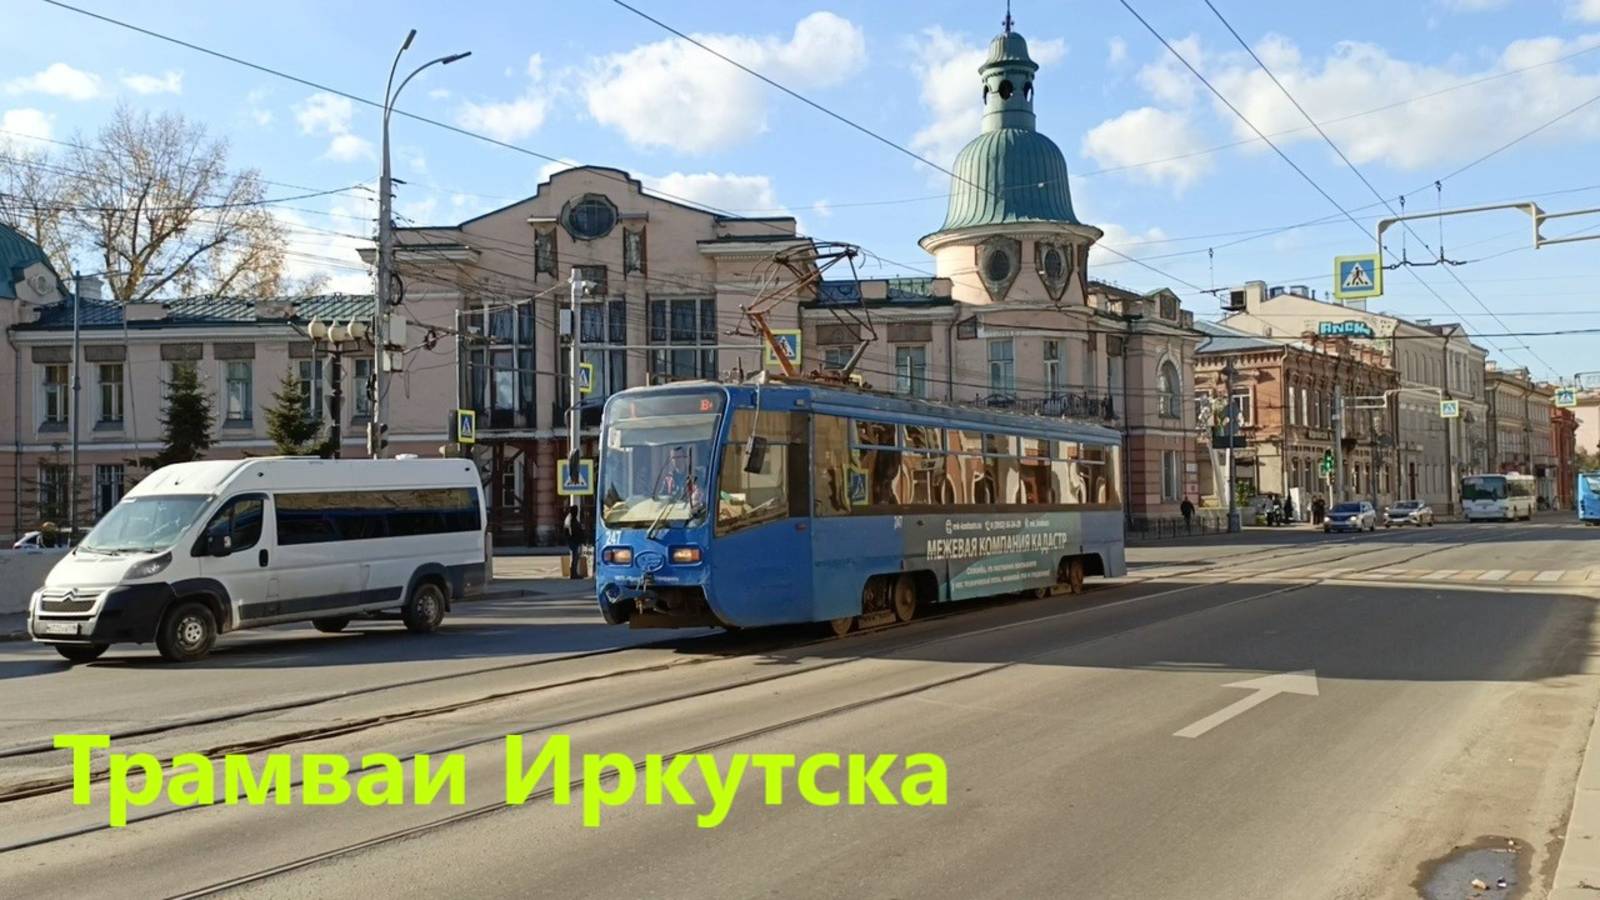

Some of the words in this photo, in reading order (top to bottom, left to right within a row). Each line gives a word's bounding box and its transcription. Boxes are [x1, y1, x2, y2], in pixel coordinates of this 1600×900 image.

[605, 530, 622, 545] 247
[927, 537, 978, 561] МЕЖЕВАЯ
[979, 532, 1031, 556] КОМПАНИЯ
[1031, 532, 1068, 554] КАДАСТР
